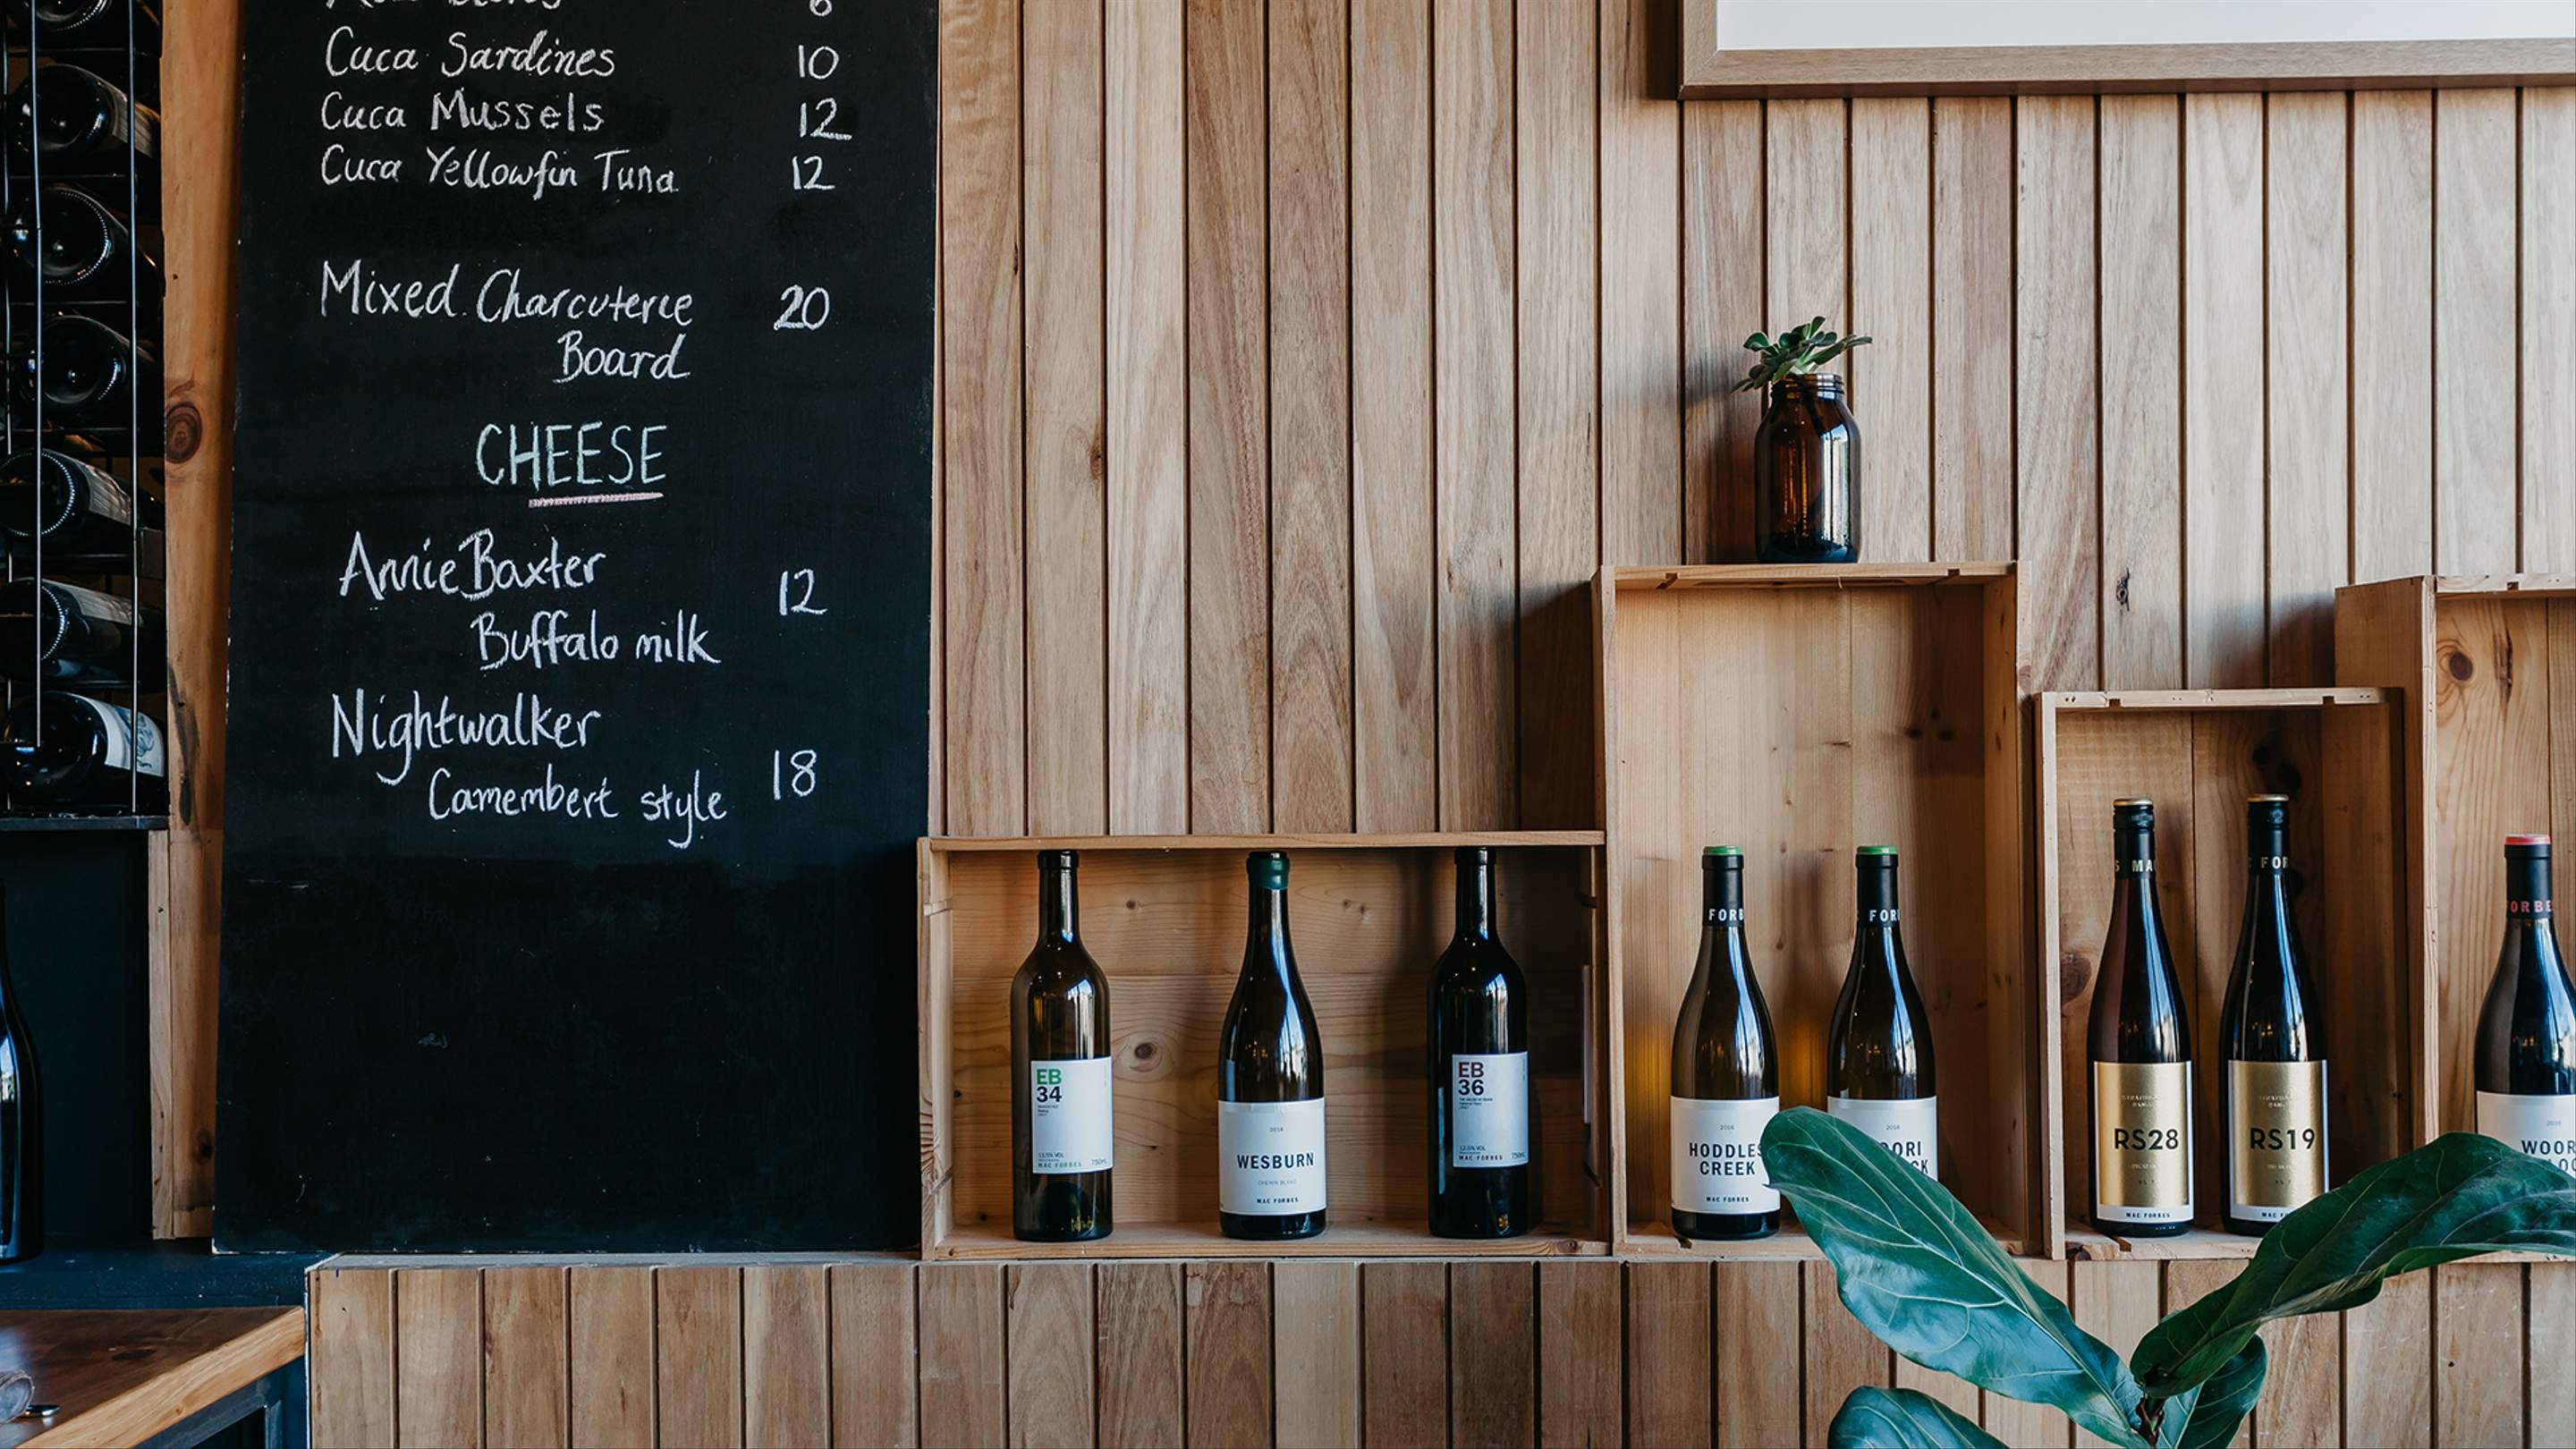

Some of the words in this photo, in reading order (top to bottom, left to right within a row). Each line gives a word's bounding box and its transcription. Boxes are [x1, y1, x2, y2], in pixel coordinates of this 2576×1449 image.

[326, 26, 418, 77] Cuca
[442, 30, 615, 77] Sardines
[799, 45, 840, 80] 10
[322, 91, 406, 131] Cuca
[431, 88, 605, 131] Mussels
[800, 98, 852, 140] 12
[322, 144, 402, 184] Cuca
[427, 147, 578, 199] Yellowfin
[594, 149, 678, 193] Tuna
[792, 157, 835, 190] 12
[322, 259, 458, 318] Mixed
[774, 285, 830, 331] 20
[553, 330, 691, 384] Board
[477, 421, 667, 486] CHEESE
[339, 531, 459, 600] Annie
[458, 528, 606, 601] Baxter
[780, 569, 827, 615] 12
[470, 610, 619, 670] Buffalo
[635, 609, 721, 665] milk
[332, 688, 601, 785] Nightwalker
[774, 750, 817, 800] 18
[428, 764, 619, 819] Camembert
[641, 768, 727, 849] style
[2131, 860, 2157, 872] MA
[1869, 909, 1900, 922] FOR
[2508, 900, 2553, 912] ORBE
[1037, 1068, 1063, 1085] EB
[1458, 1079, 1485, 1096] 36
[1459, 1062, 1485, 1078] EB
[1036, 1086, 1063, 1103] 34
[1237, 1151, 1315, 1170] WESBURN
[2114, 1128, 2179, 1151] RS28
[2250, 1127, 2316, 1150] RS19
[1699, 1160, 1756, 1176] CREEK
